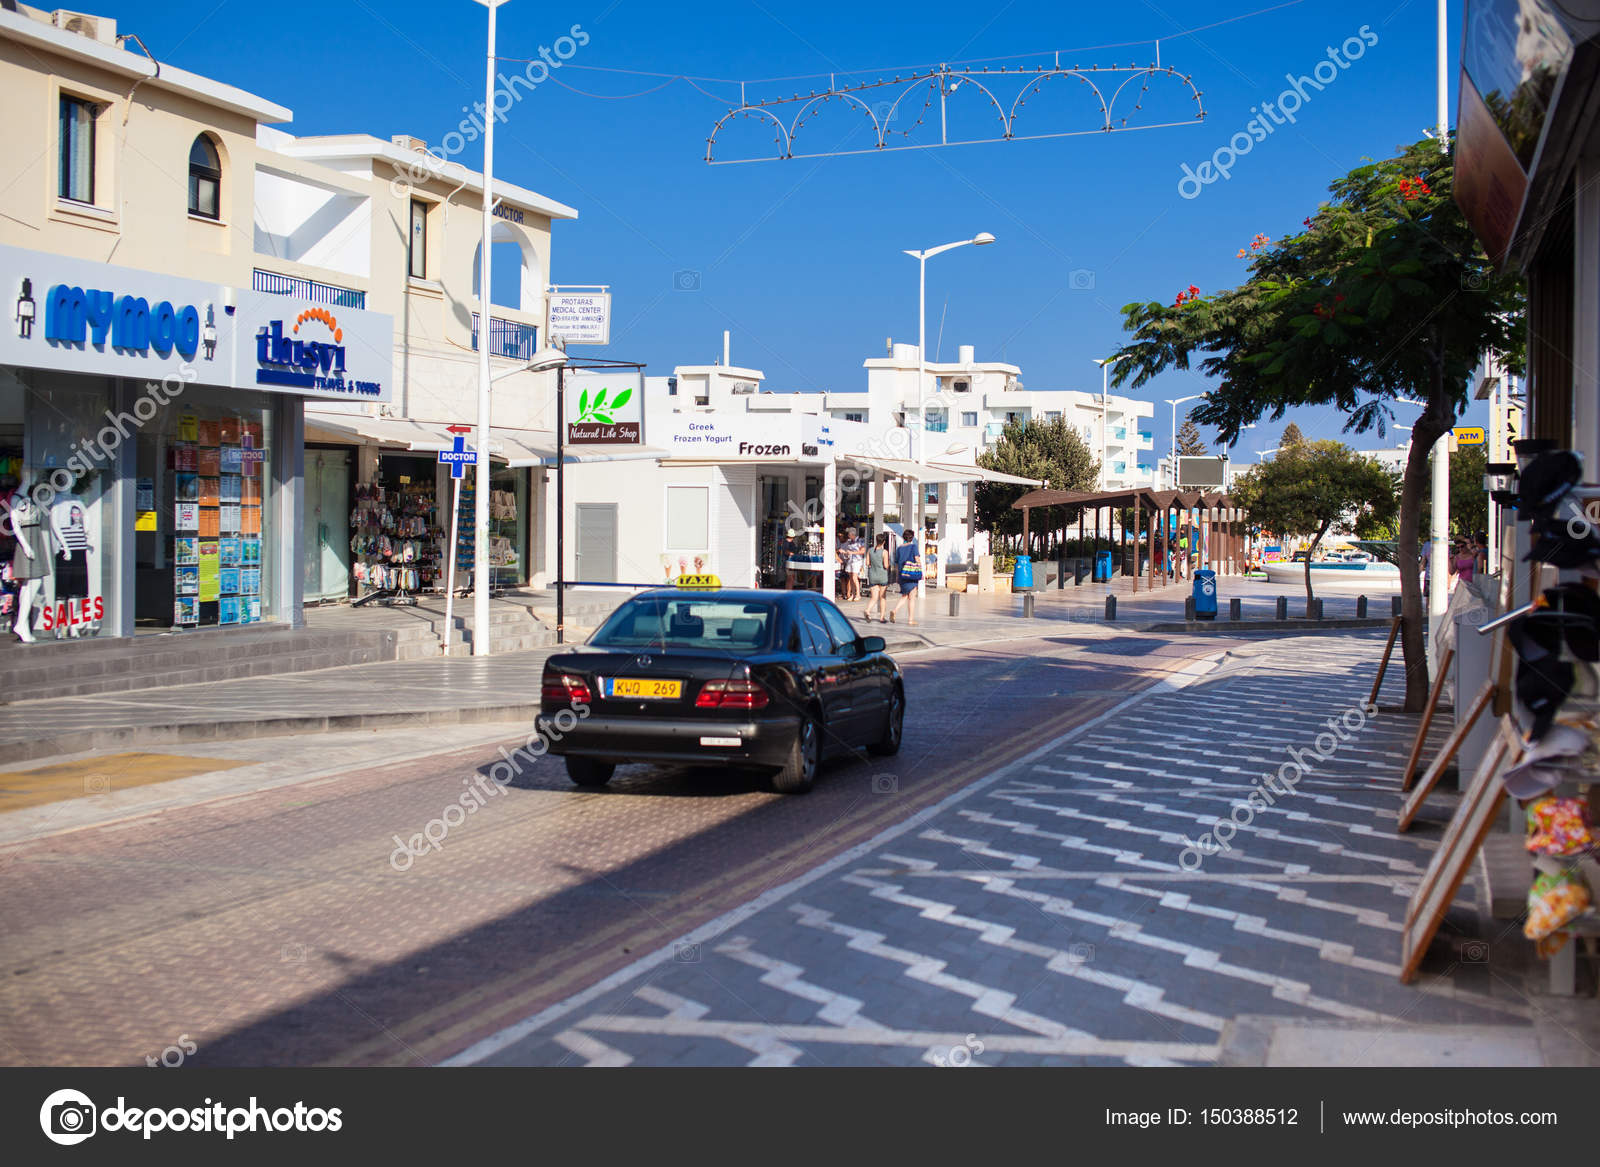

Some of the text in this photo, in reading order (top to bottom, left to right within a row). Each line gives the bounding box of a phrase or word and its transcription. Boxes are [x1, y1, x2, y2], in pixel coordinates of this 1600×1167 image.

[492, 204, 524, 225] DOCTOR
[561, 298, 593, 306] PROTARAS
[552, 306, 601, 314] MEDICAL CENTER
[315, 376, 346, 393] TRAVEL
[355, 380, 381, 396] TOURS
[688, 422, 715, 431] Greek
[570, 426, 600, 439] Natural
[618, 426, 637, 442] Shop
[673, 434, 732, 445] Frozen Yogurt
[1459, 432, 1479, 440] ATM
[739, 442, 791, 456] Frozen
[441, 452, 476, 461] DOCTOR
[679, 575, 714, 585] TAXI
[43, 595, 104, 631] SALES
[615, 682, 677, 695] KWQ 269
